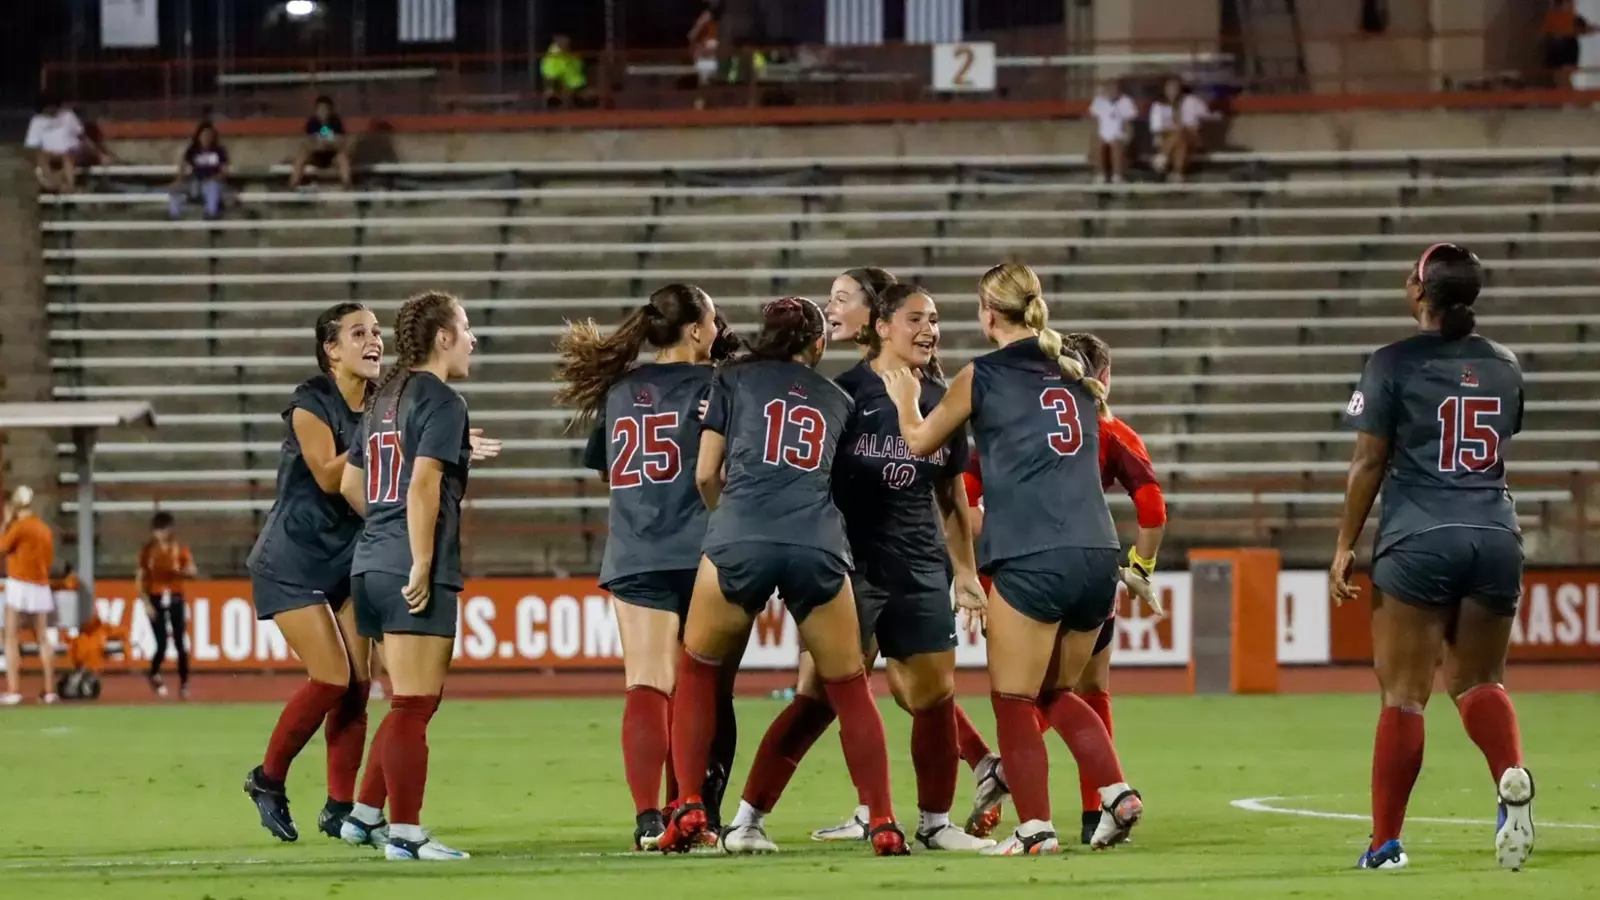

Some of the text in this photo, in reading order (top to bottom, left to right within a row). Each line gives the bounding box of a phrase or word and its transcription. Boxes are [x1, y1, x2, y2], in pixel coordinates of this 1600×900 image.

[953, 46, 975, 86] 2
[610, 411, 682, 490] 25
[763, 398, 827, 472] 13
[854, 433, 944, 466] ALABA
[1039, 387, 1083, 456] 3
[1437, 396, 1501, 473] 15
[365, 430, 402, 504] 17
[882, 462, 916, 490] 10
